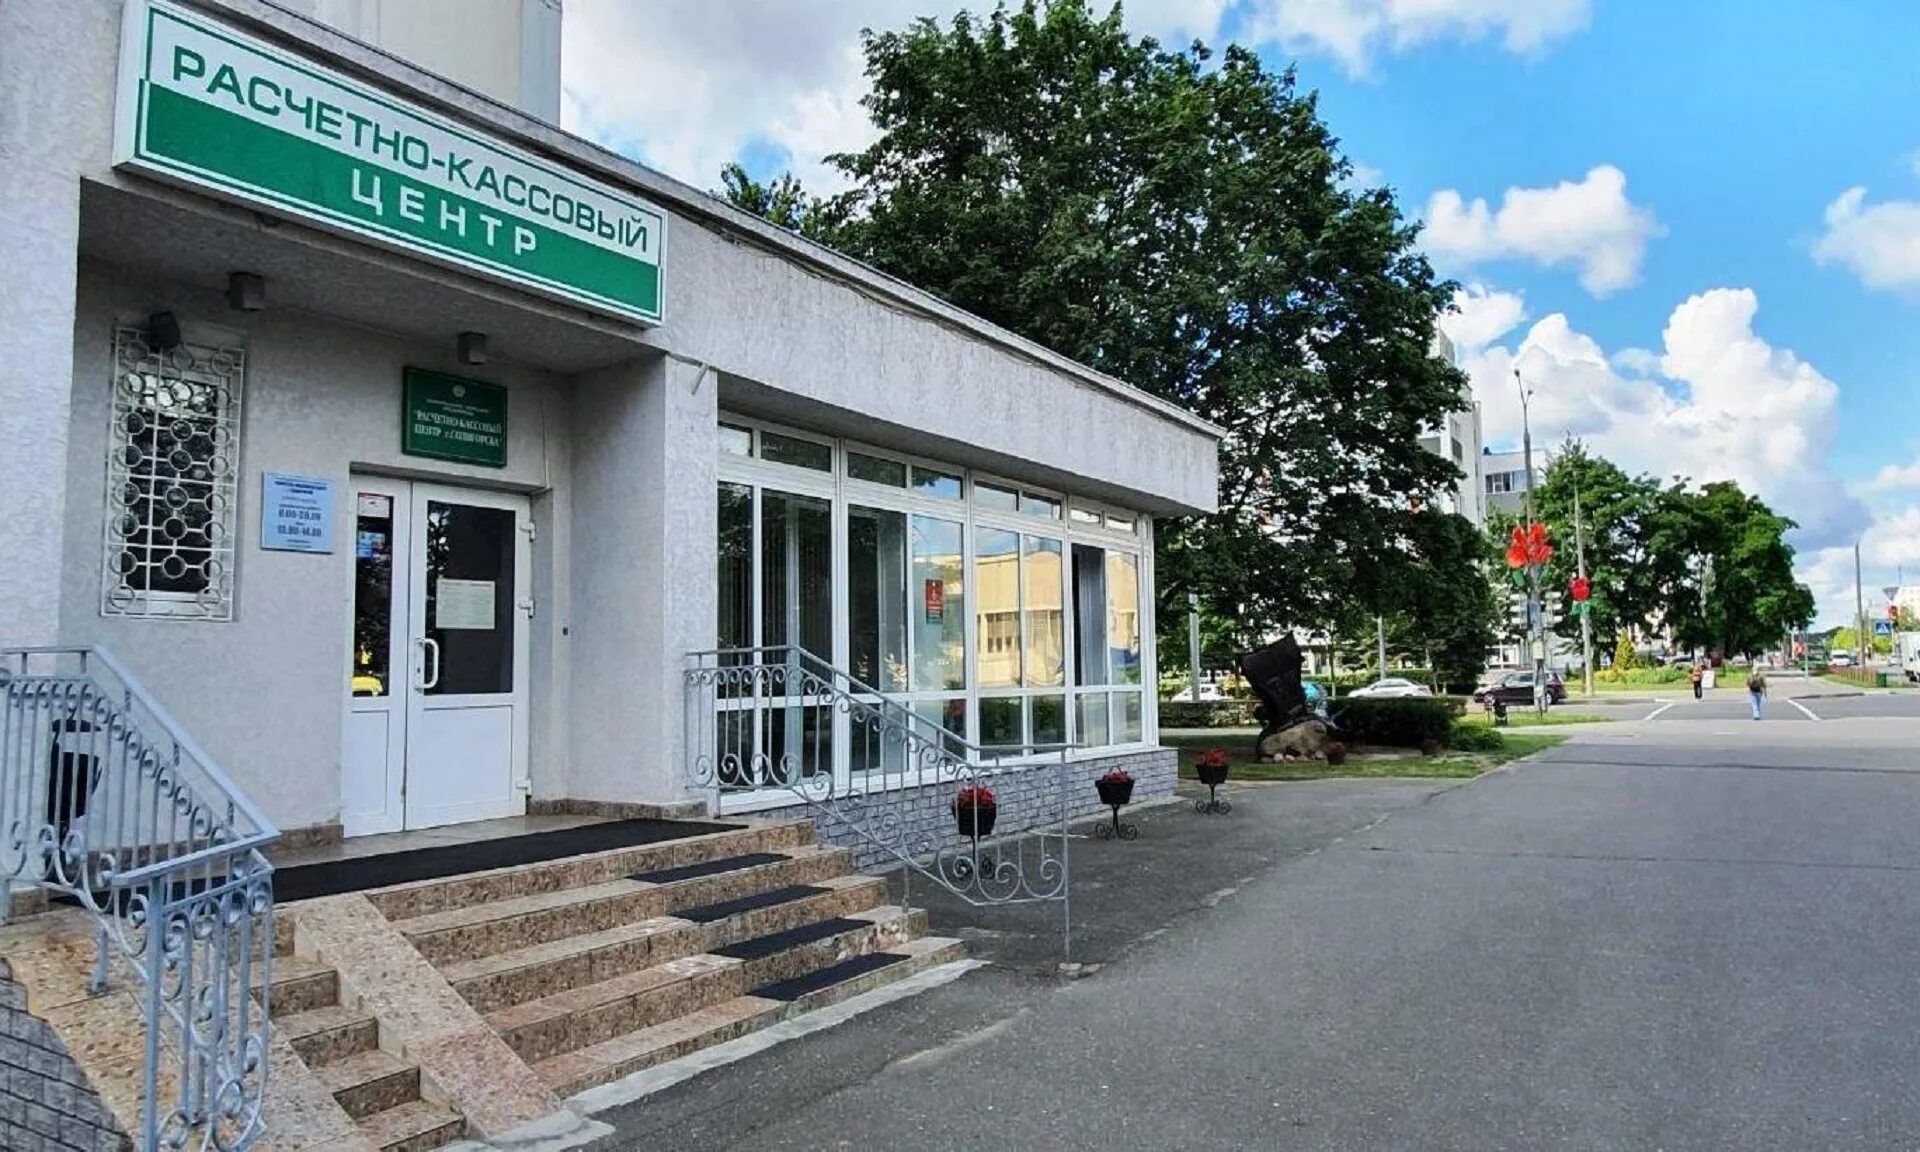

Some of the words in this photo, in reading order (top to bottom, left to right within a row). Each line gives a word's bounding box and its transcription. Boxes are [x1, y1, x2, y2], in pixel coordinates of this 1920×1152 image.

[172, 45, 648, 253] РАСЧЕТНО-КАССОВЫЙ
[351, 168, 537, 256] ЦЕНТР
[414, 423, 442, 438] ЦЕНТР
